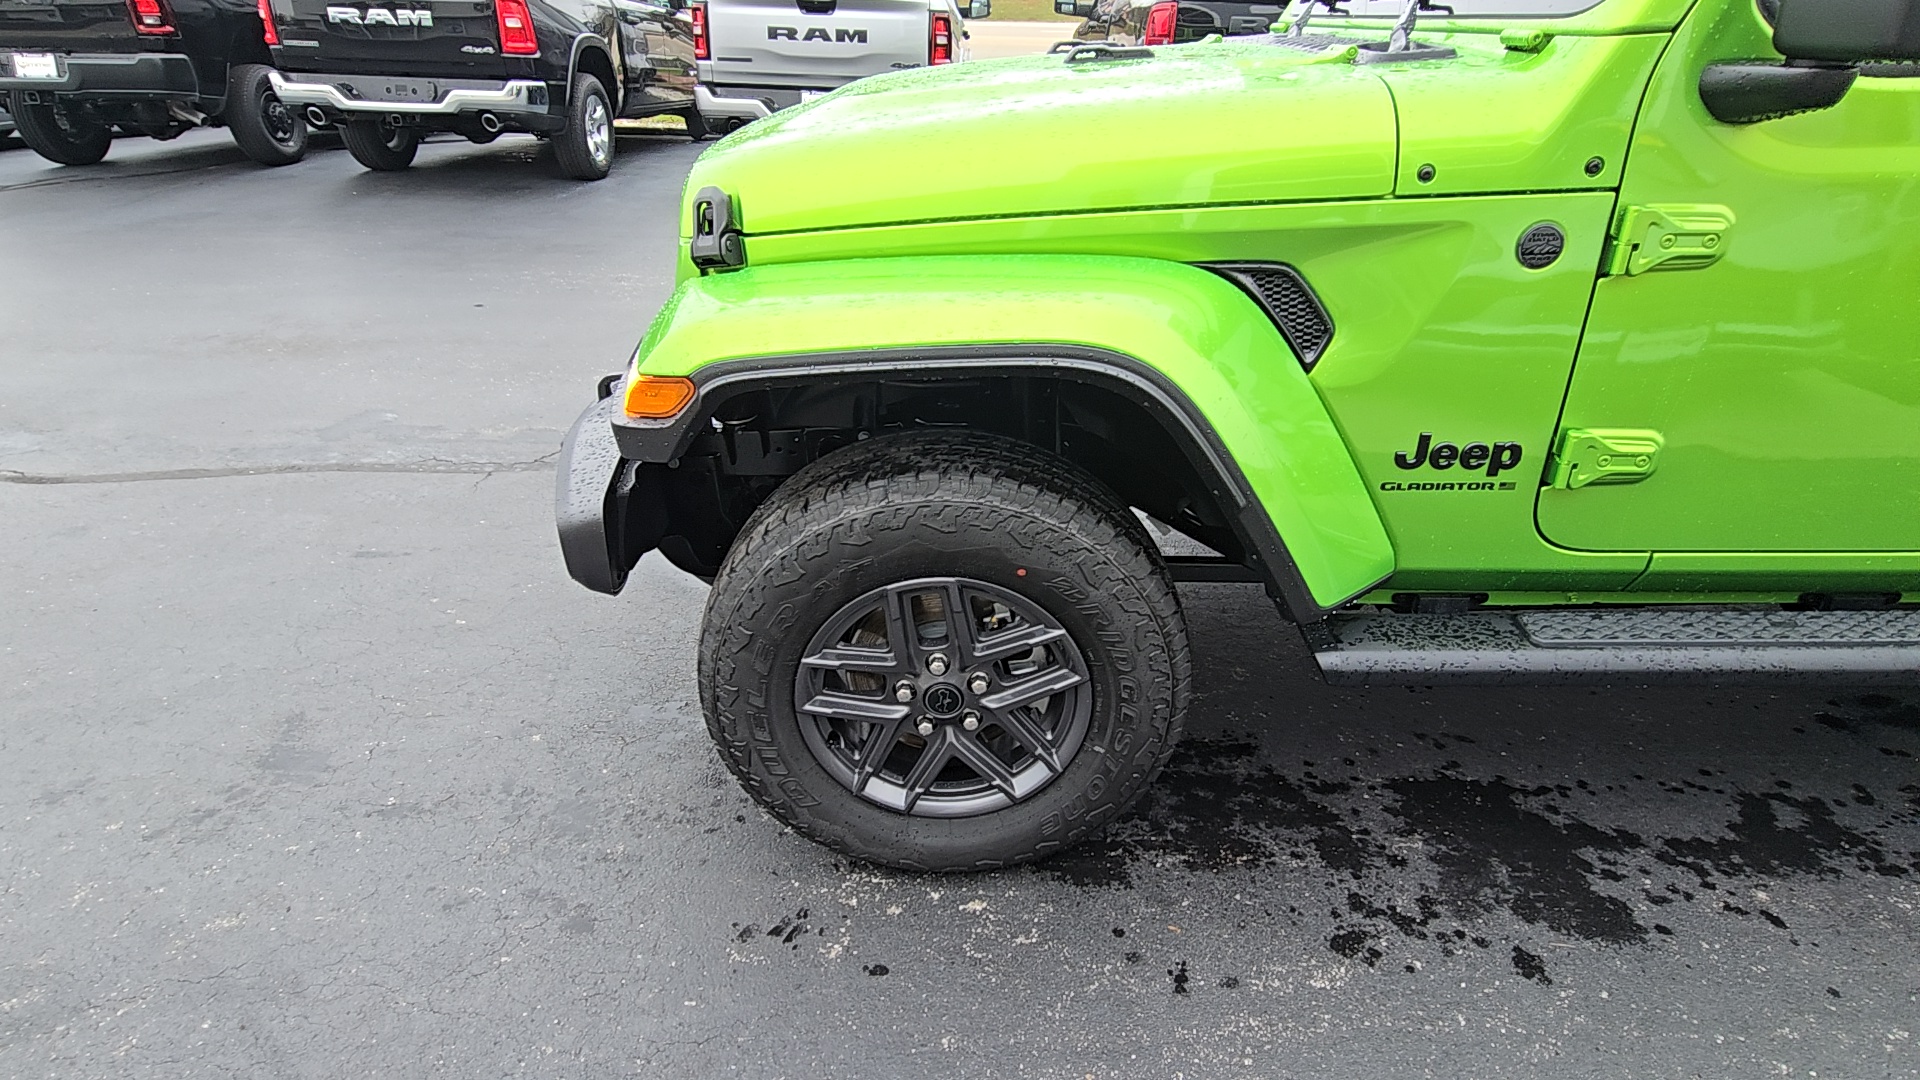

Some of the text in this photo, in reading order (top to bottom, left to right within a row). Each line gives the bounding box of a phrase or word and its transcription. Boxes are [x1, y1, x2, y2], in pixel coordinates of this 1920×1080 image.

[326, 6, 433, 27] RAM
[767, 25, 868, 44] RAM
[1393, 431, 1523, 477] Jeep
[1380, 482, 1496, 491] GLADIATOR
[1041, 575, 1140, 836] BRIDGESTONE
